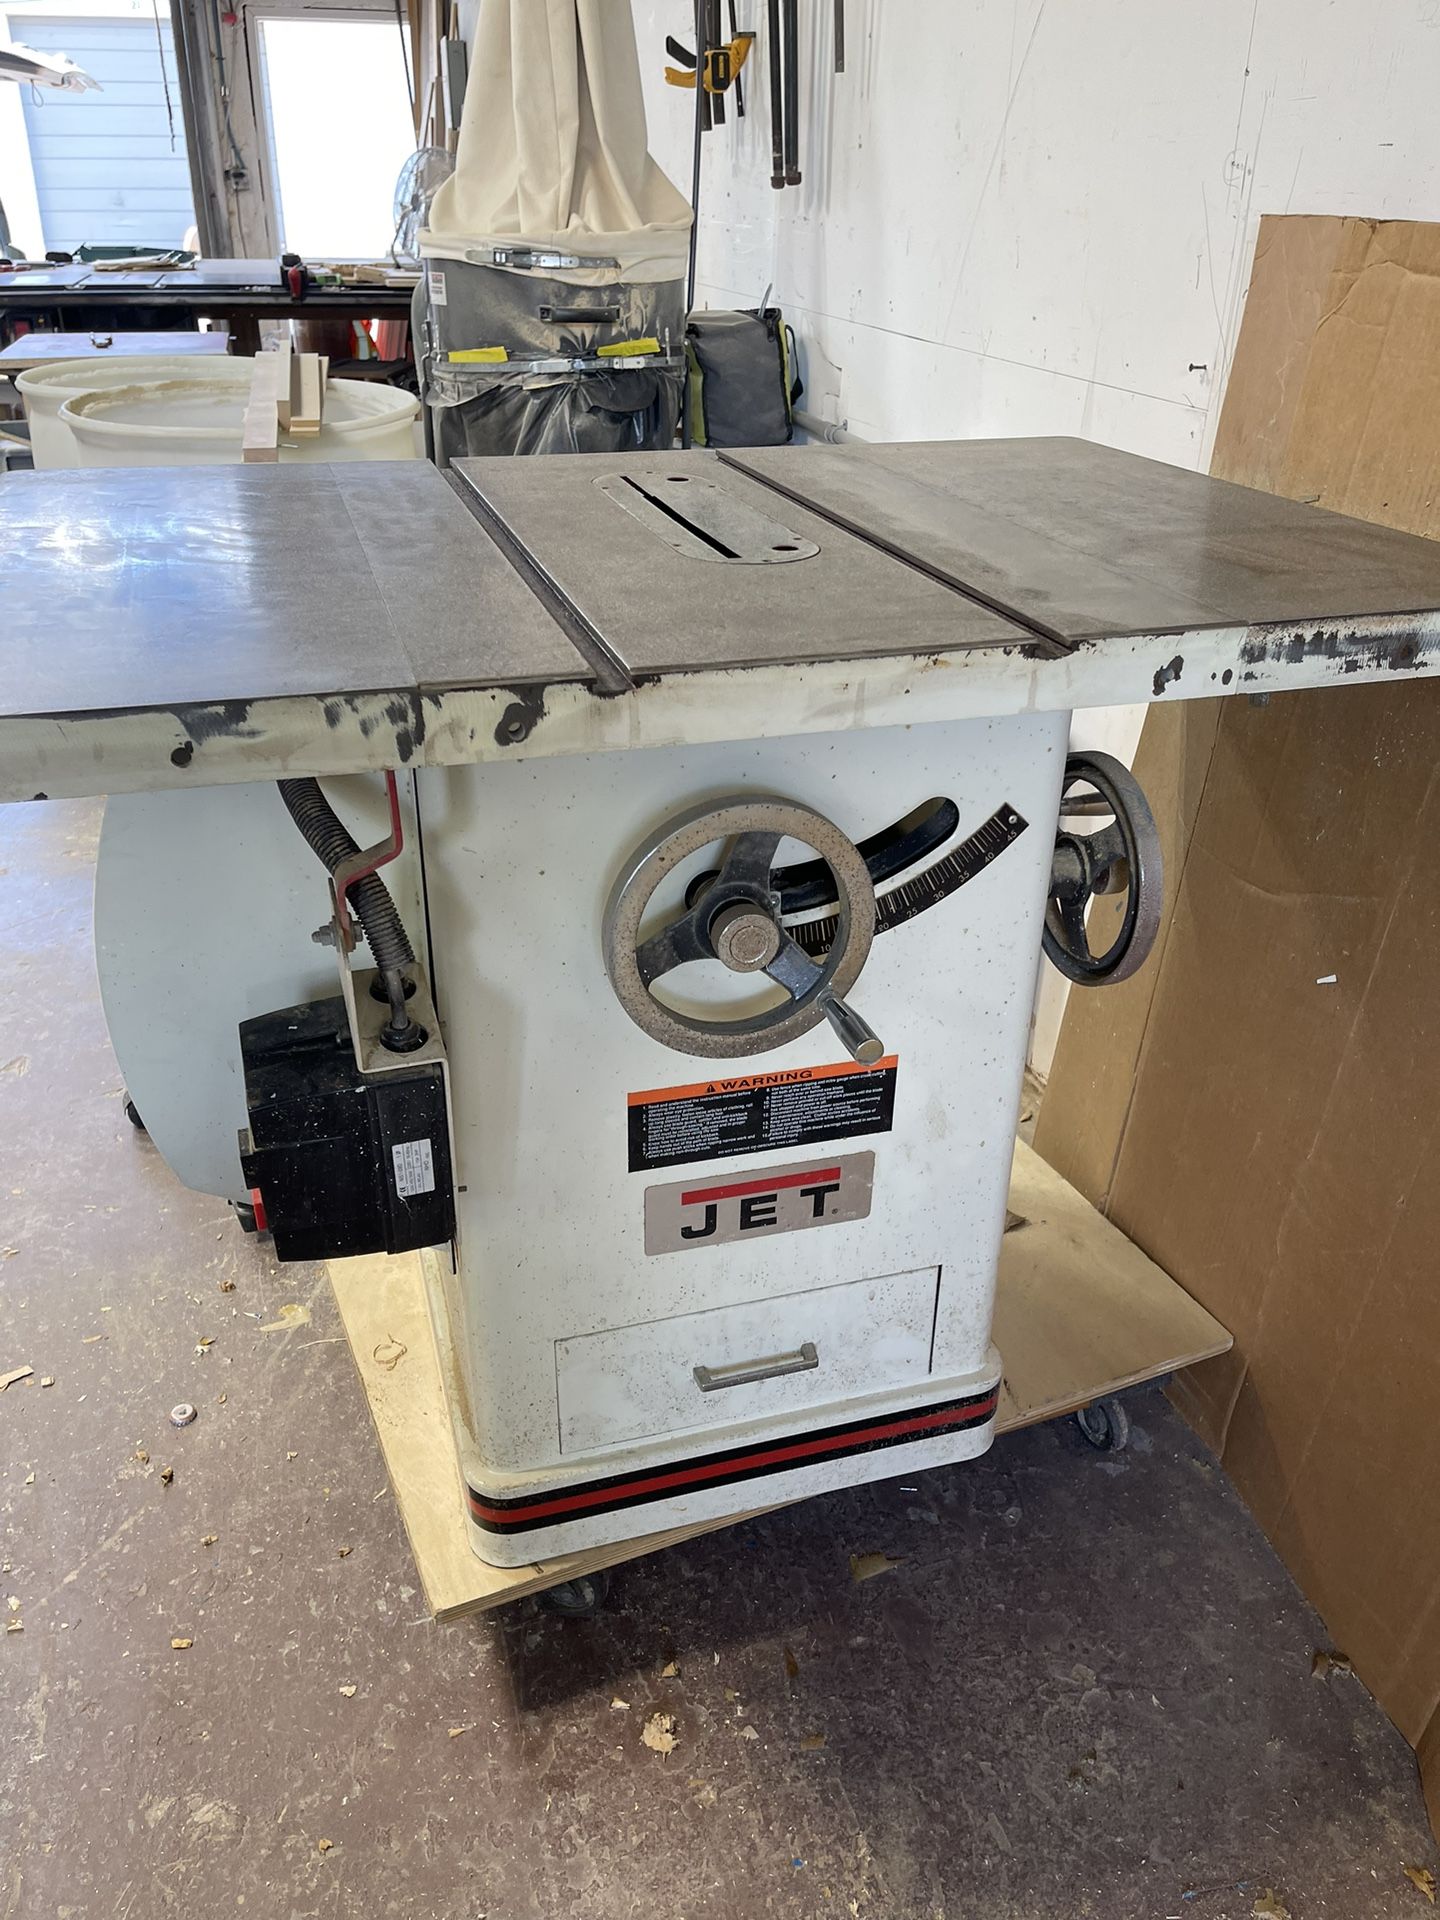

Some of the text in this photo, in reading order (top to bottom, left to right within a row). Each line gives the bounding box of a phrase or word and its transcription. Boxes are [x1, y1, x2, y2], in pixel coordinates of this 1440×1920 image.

[1007, 831, 1016, 840] 45
[984, 851, 995, 863] 40
[958, 871, 970, 883] 35
[933, 890, 945, 902] 30
[906, 907, 918, 918] 25
[721, 1070, 813, 1090] WARNING
[680, 1182, 840, 1240] JET
